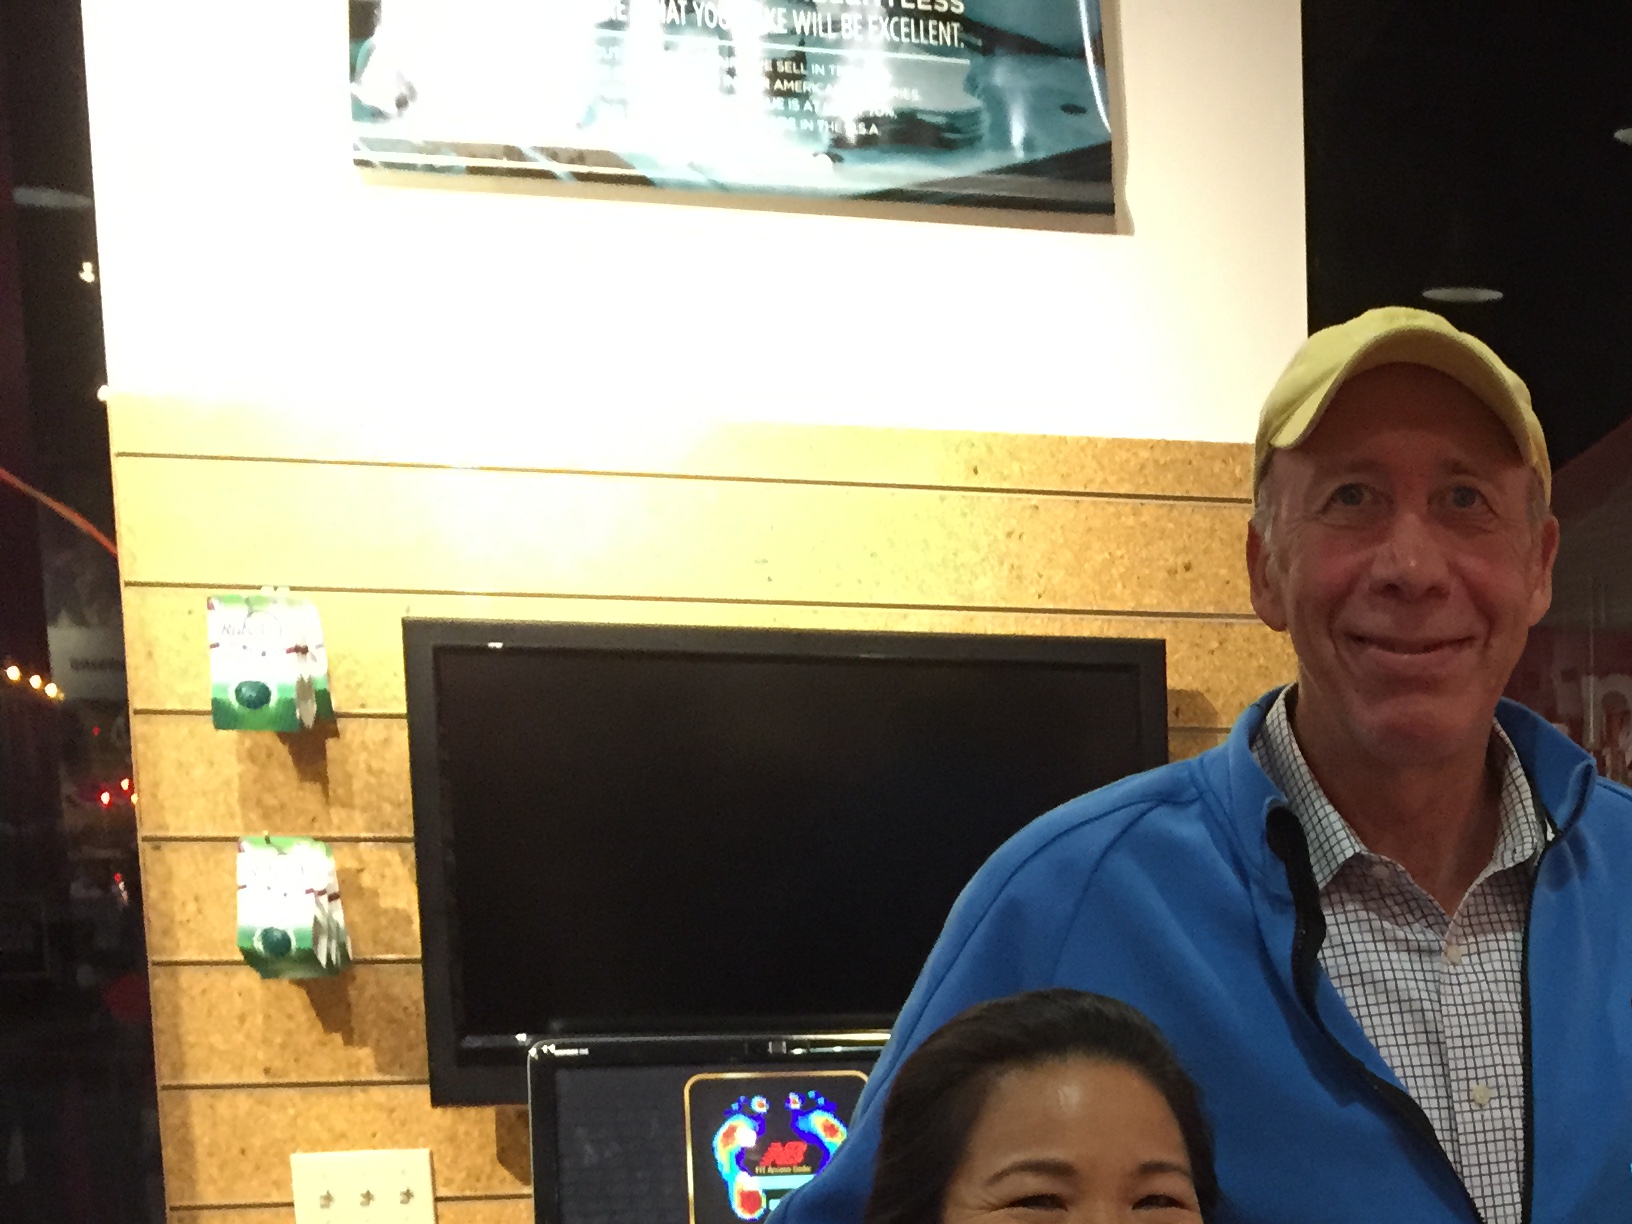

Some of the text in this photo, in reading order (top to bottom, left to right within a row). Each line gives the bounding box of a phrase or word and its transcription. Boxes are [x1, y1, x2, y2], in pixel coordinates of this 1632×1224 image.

[793, 9, 838, 39] WILL
[841, 12, 863, 42] BE
[867, 16, 965, 48] EXCELLENT.
